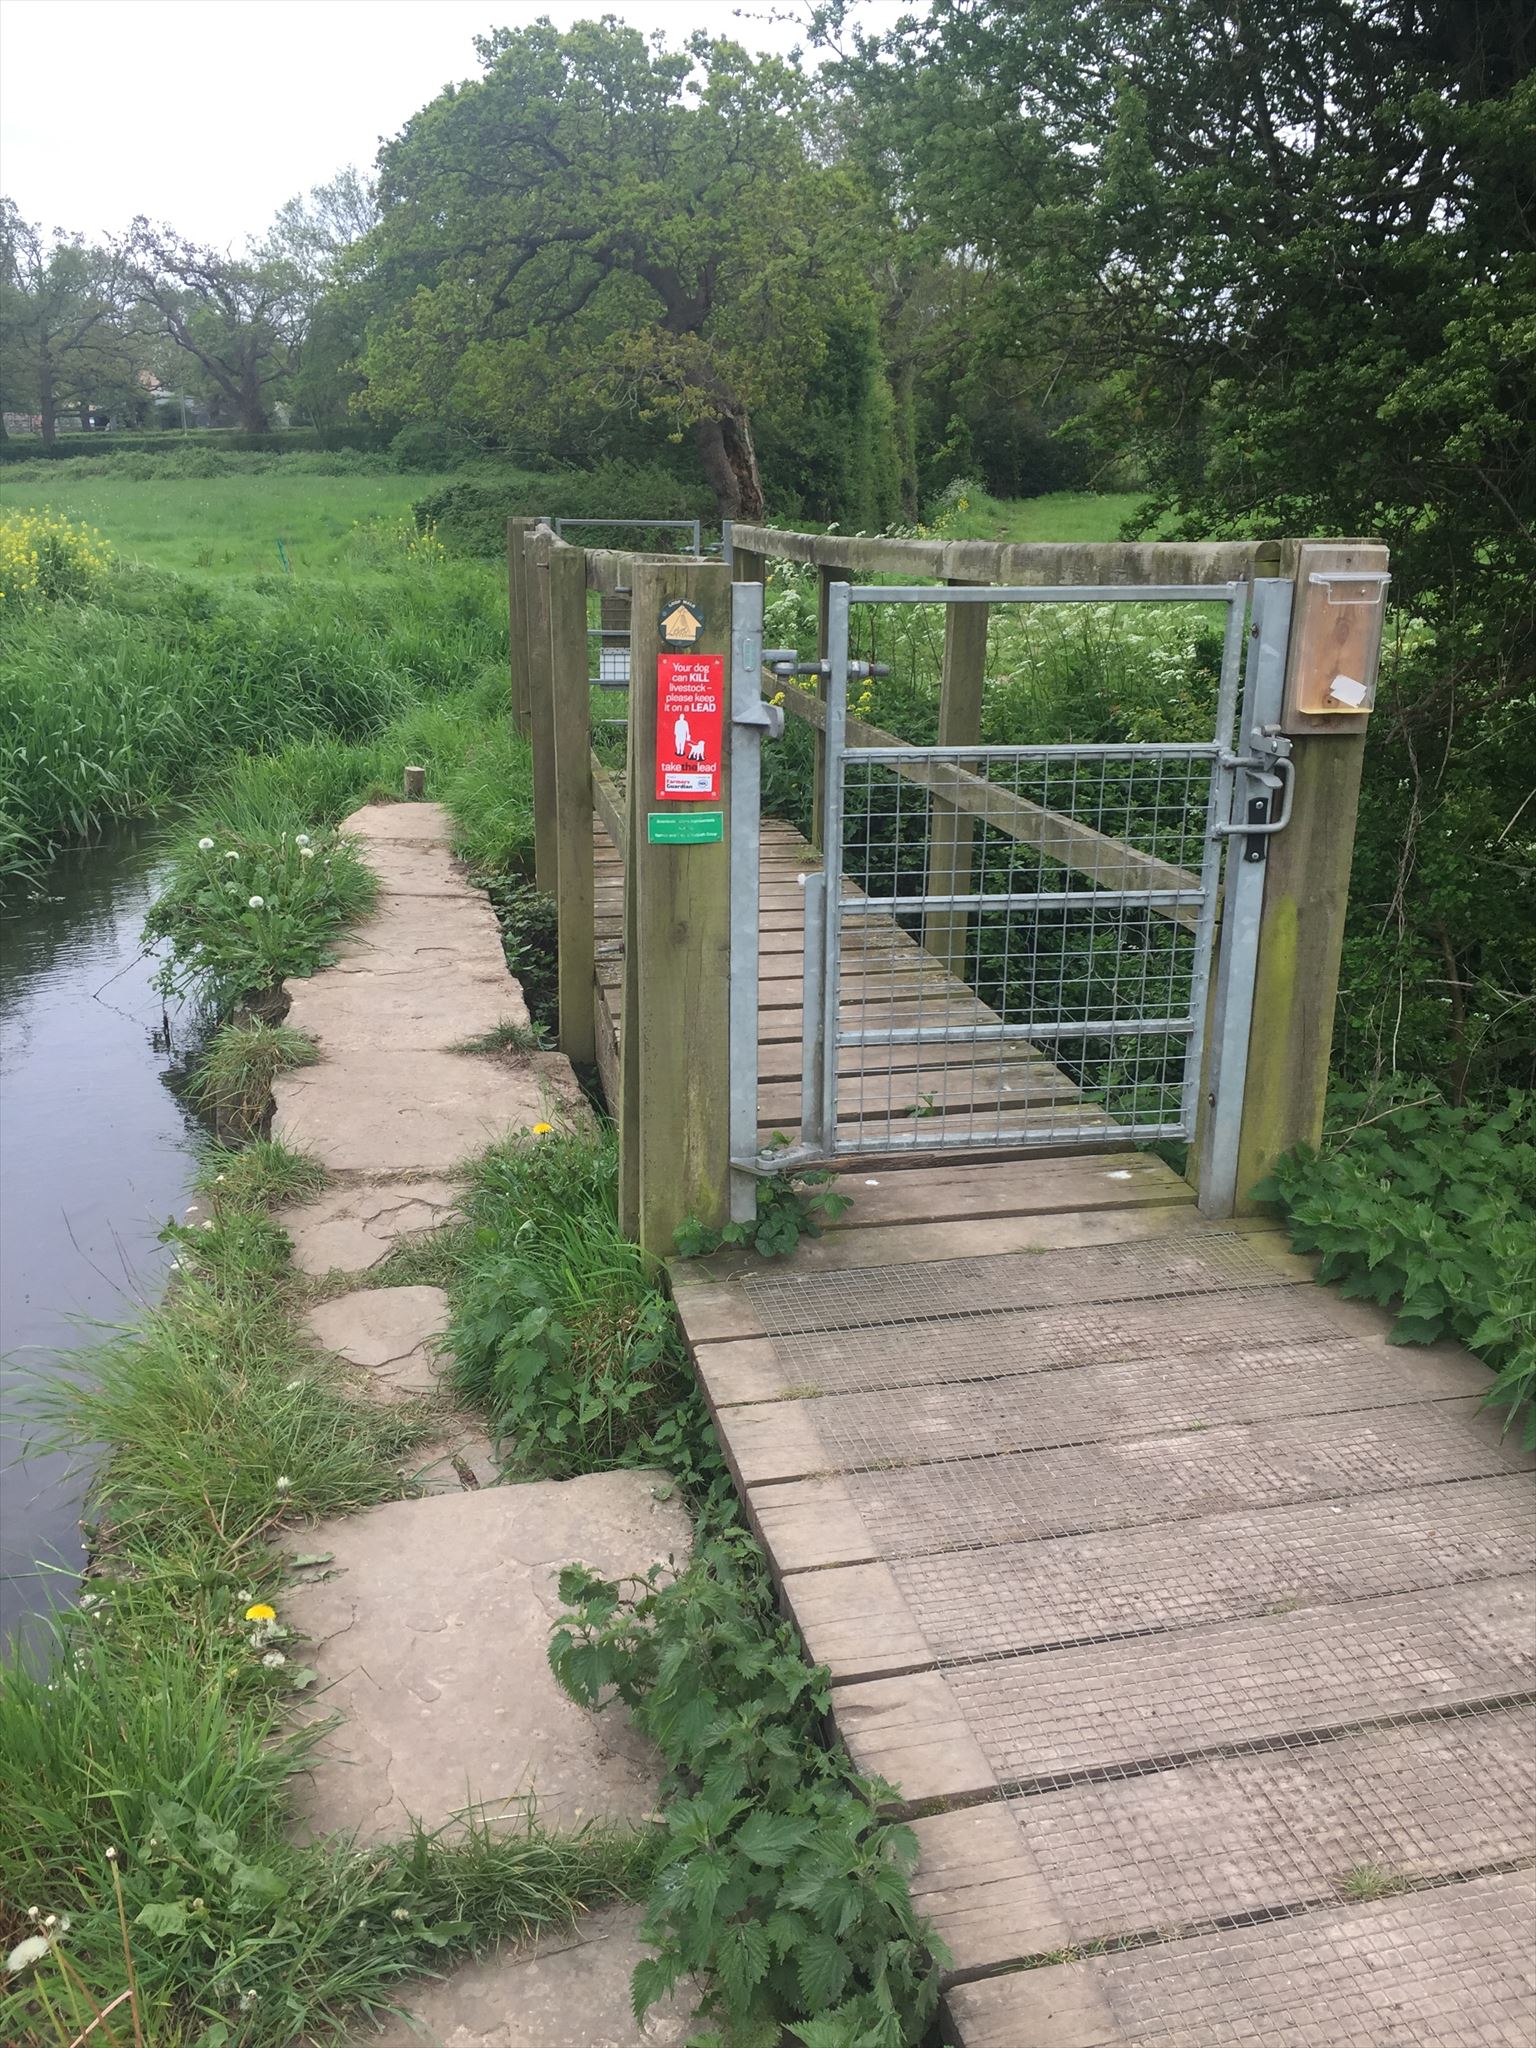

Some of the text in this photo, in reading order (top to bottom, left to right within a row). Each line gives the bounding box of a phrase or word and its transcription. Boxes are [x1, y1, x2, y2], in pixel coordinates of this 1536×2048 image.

[672, 662, 710, 673] Your dog
[672, 673, 710, 682] can KILL
[669, 683, 706, 692] livestock
[666, 693, 715, 703] please keep
[664, 704, 670, 712] it
[691, 703, 716, 712] LEAD
